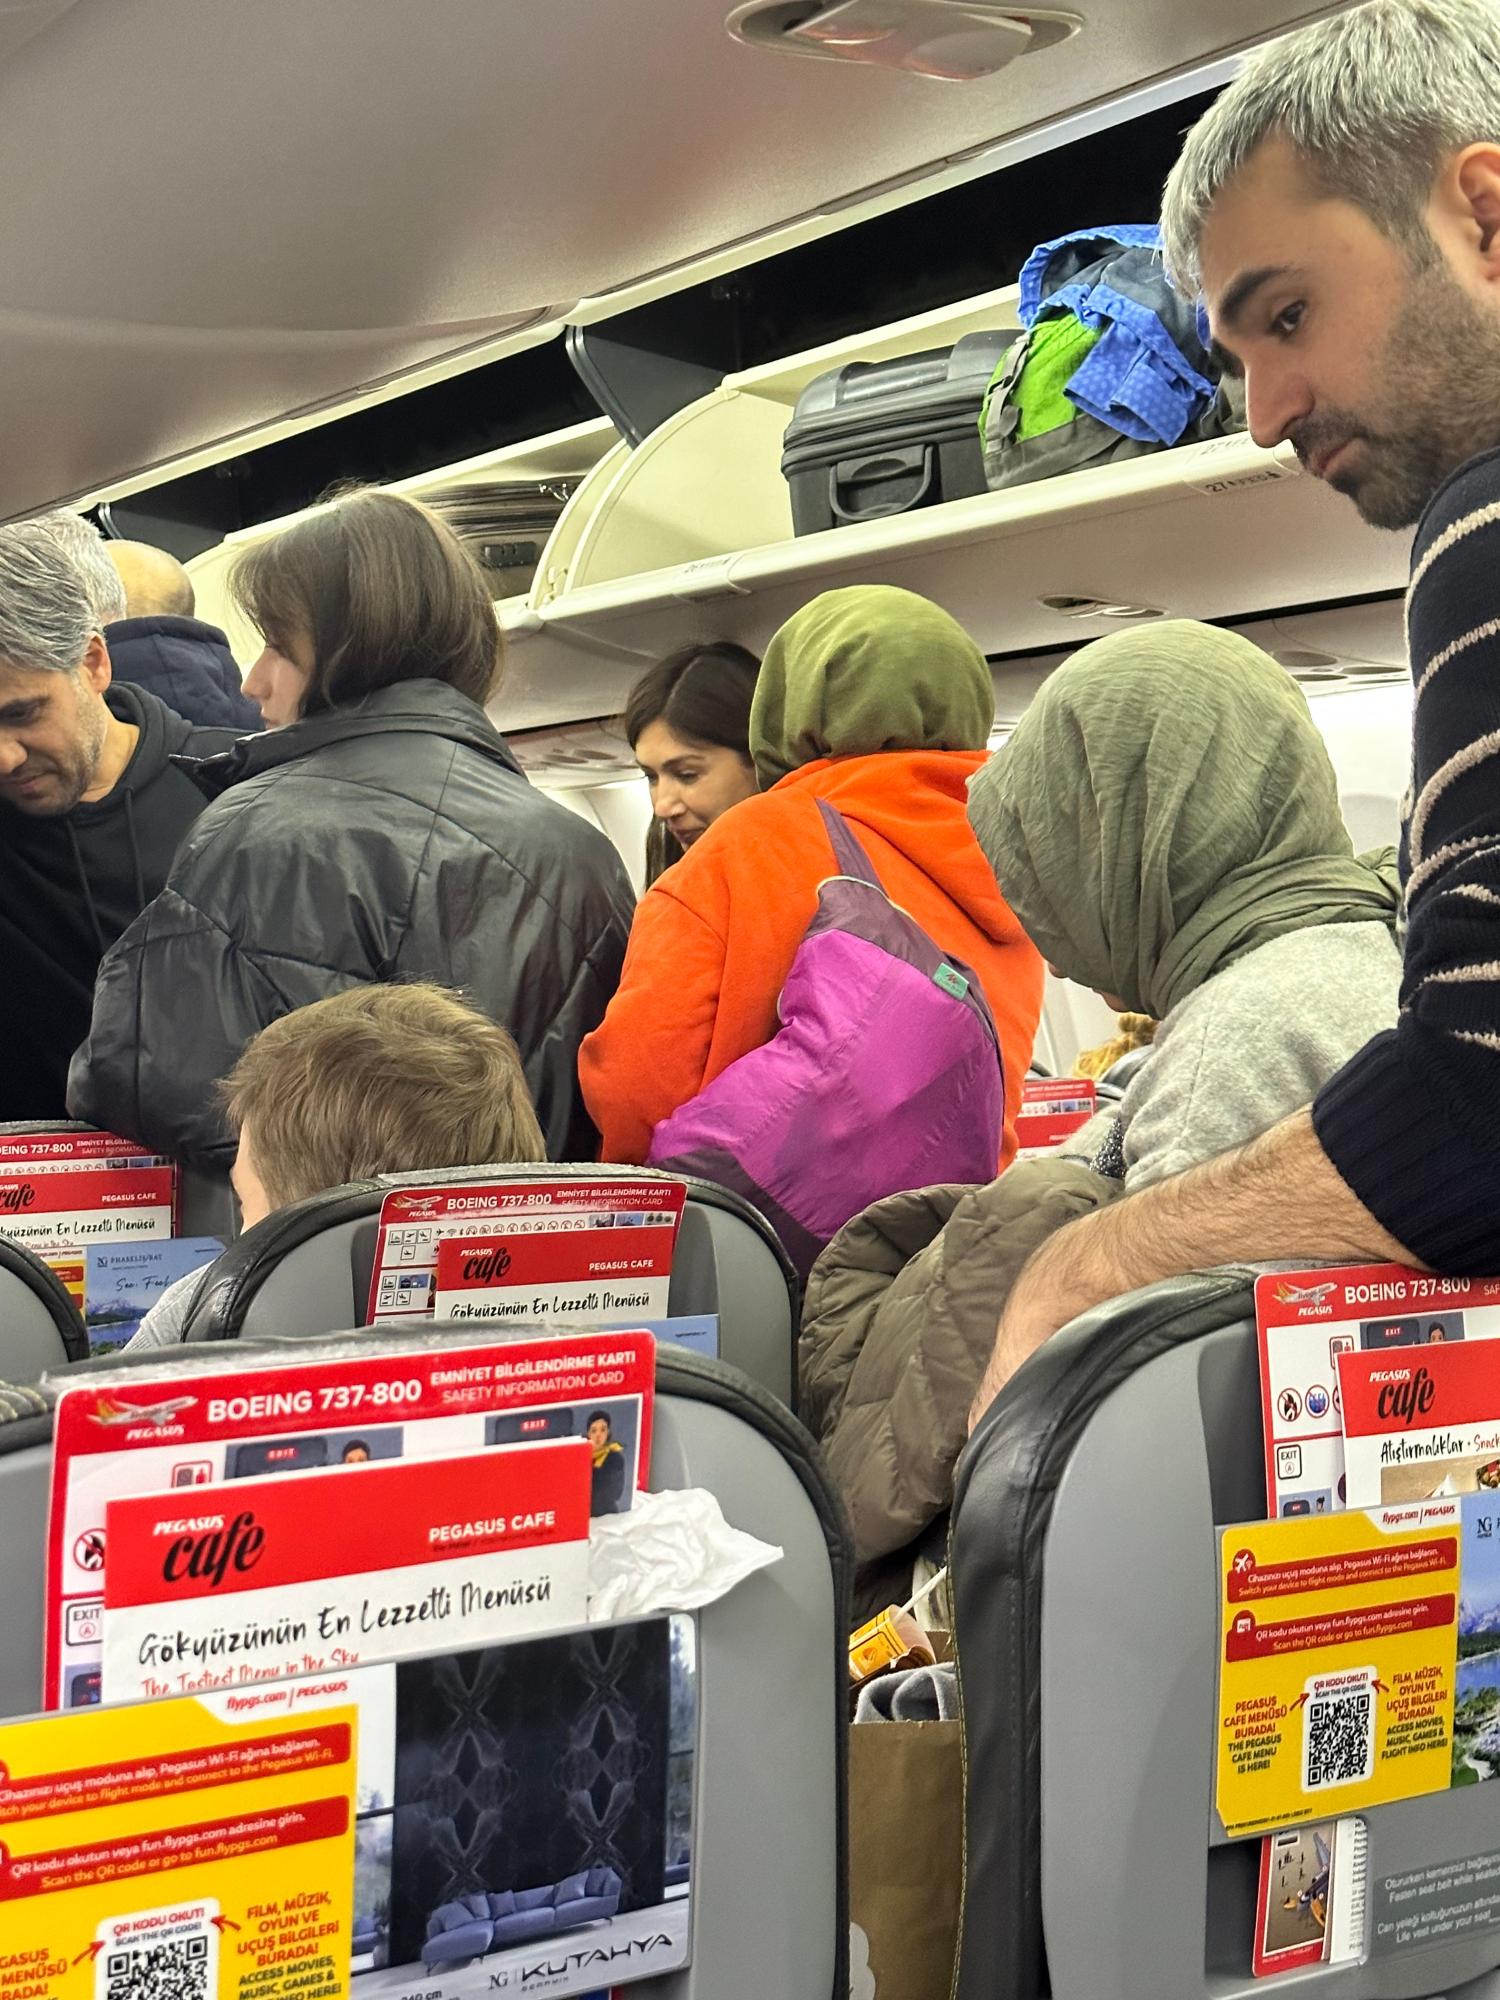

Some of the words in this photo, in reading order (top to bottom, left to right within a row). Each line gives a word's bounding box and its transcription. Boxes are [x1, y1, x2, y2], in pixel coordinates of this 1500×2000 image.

[0, 1146, 27, 1155] EING
[31, 1143, 73, 1155] 737-800
[102, 1194, 135, 1202] PEGASUS
[447, 1197, 498, 1211] BOEING
[500, 1194, 552, 1208] 737-800
[557, 1190, 590, 1198] EMNİYET
[591, 1188, 647, 1198] BİLGİLENDİRME
[648, 1189, 672, 1197] KARTI
[590, 1198, 640, 1207] INFORMATION
[1, 1225, 52, 1240] kyüzünün
[56, 1223, 70, 1235] En
[115, 1218, 155, 1231] Menüsü
[460, 1248, 494, 1257] PEGASUS
[463, 1247, 512, 1283] cafe
[589, 1262, 629, 1271] PEGASUS
[630, 1260, 654, 1268] CAFE
[1344, 1282, 1407, 1305] BOEING
[1409, 1277, 1471, 1297] 737-800
[1483, 1284, 1500, 1296] SAF
[532, 1298, 549, 1313] En
[553, 1293, 599, 1313] Lezzetli
[602, 1292, 650, 1308] Menüsü
[1298, 1305, 1333, 1317] PEGASUS
[1385, 1328, 1401, 1336] EXIT
[430, 1366, 493, 1386] EMNİYET
[494, 1355, 596, 1380] BİLGİLENDİRME
[597, 1350, 637, 1366] KARTI
[1369, 1369, 1411, 1383] PEGASUS
[442, 1385, 493, 1403] SAFETY
[496, 1375, 586, 1397] INFORMATION
[588, 1371, 625, 1387] CARD
[1378, 1368, 1436, 1425] cafe
[207, 1390, 313, 1423] BOEING
[318, 1379, 422, 1408] 737-800
[126, 1424, 186, 1441] PEGASUS
[1281, 1450, 1298, 1461] EXIT
[1382, 1510, 1419, 1524] flypgs.com
[1424, 1504, 1456, 1517] PEGASUS
[153, 1515, 226, 1536] PEGASUS
[429, 1517, 506, 1542] PEGASUS
[511, 1511, 556, 1530] CAFE
[1477, 1517, 1493, 1534] NG
[163, 1511, 266, 1587] cafe
[73, 1608, 101, 1622] EXIT
[139, 1618, 306, 1667] Gökyüzünün
[318, 1606, 351, 1640] En
[360, 1583, 451, 1634] Lezzetli
[461, 1576, 552, 1616] Menüsü
[141, 1677, 170, 1697] The
[177, 1666, 234, 1691] Tastiest
[240, 1664, 280, 1681] Menu
[286, 1661, 298, 1674] in
[302, 1654, 326, 1670] the
[1393, 1672, 1413, 1684] FİLM,
[1414, 1666, 1443, 1681] MÜZİK,
[227, 1691, 287, 1711] flypgs.com
[296, 1680, 349, 1698] PEGASUS
[1399, 1683, 1424, 1696] OYUN
[1425, 1680, 1436, 1690] VE
[1235, 1696, 1278, 1712] PEGASUS
[1386, 1698, 1410, 1713] UÇUŞ
[1411, 1690, 1448, 1706] BİLGİLERİ
[1224, 1715, 1247, 1728] CAFE
[1248, 1705, 1288, 1723] MENÜSÜ
[1398, 1706, 1435, 1722] BURADA!
[1234, 1723, 1276, 1739] BURADA!
[1228, 1742, 1244, 1753] THE
[1245, 1734, 1282, 1749] PEGASUS
[1232, 1753, 1252, 1764] CAFE
[1253, 1747, 1278, 1760] MENU
[84, 1770, 134, 1787] moduna
[160, 1759, 207, 1775] Pegasus
[208, 1751, 239, 1765] Wi-Fi
[1237, 1766, 1246, 1774] IS
[1247, 1760, 1271, 1773] HERE!
[12, 1862, 32, 1879] QR
[33, 1857, 65, 1873] kodu
[66, 1848, 110, 1866] okutun
[112, 1846, 140, 1860] veya
[142, 1828, 227, 1851] fun.flypgs.com
[229, 1812, 276, 1836] adresine
[278, 1812, 306, 1828] girin.
[41, 1875, 72, 1889] Scan
[74, 1870, 95, 1882] the
[96, 1864, 117, 1880] QR
[117, 1860, 146, 1874] code
[148, 1858, 161, 1868] or
[162, 1855, 179, 1870] go
[180, 1851, 193, 1861] to
[195, 1835, 278, 1858] fun.flypgs.com
[247, 1903, 281, 1919] FİLM,
[284, 1891, 332, 1911] MÜZİK,
[113, 1924, 131, 1937] QR
[132, 1915, 167, 1931] KODU
[168, 1907, 205, 1924] OKUT!
[258, 1914, 299, 1933] OYUN
[302, 1910, 320, 1923] VE
[1378, 1923, 1394, 1935] Can
[1431, 1921, 1454, 1934] under
[1456, 1915, 1473, 1930] your
[141, 1932, 159, 1942] THE
[160, 1928, 174, 1939] QR
[237, 1935, 276, 1956] UÇUŞ
[279, 1921, 340, 1944] BİLGİLERİ
[0, 1948, 50, 1969] GASUS
[257, 1943, 319, 1967] BURADA!
[488, 1972, 509, 1991] NG
[521, 1934, 672, 1982] KUTAHYA
[1, 1958, 68, 1986] MENÜSÜ
[239, 1966, 284, 1987] ACCESS
[286, 1955, 336, 1975] MOVIES,
[0, 1983, 49, 2000] RADA!
[239, 1983, 281, 2000] MUSIC,
[283, 1972, 324, 1991] GAMES
[326, 1970, 335, 1981] &
[307, 1983, 342, 2000] HERE!
[425, 1990, 442, 2000] cm
